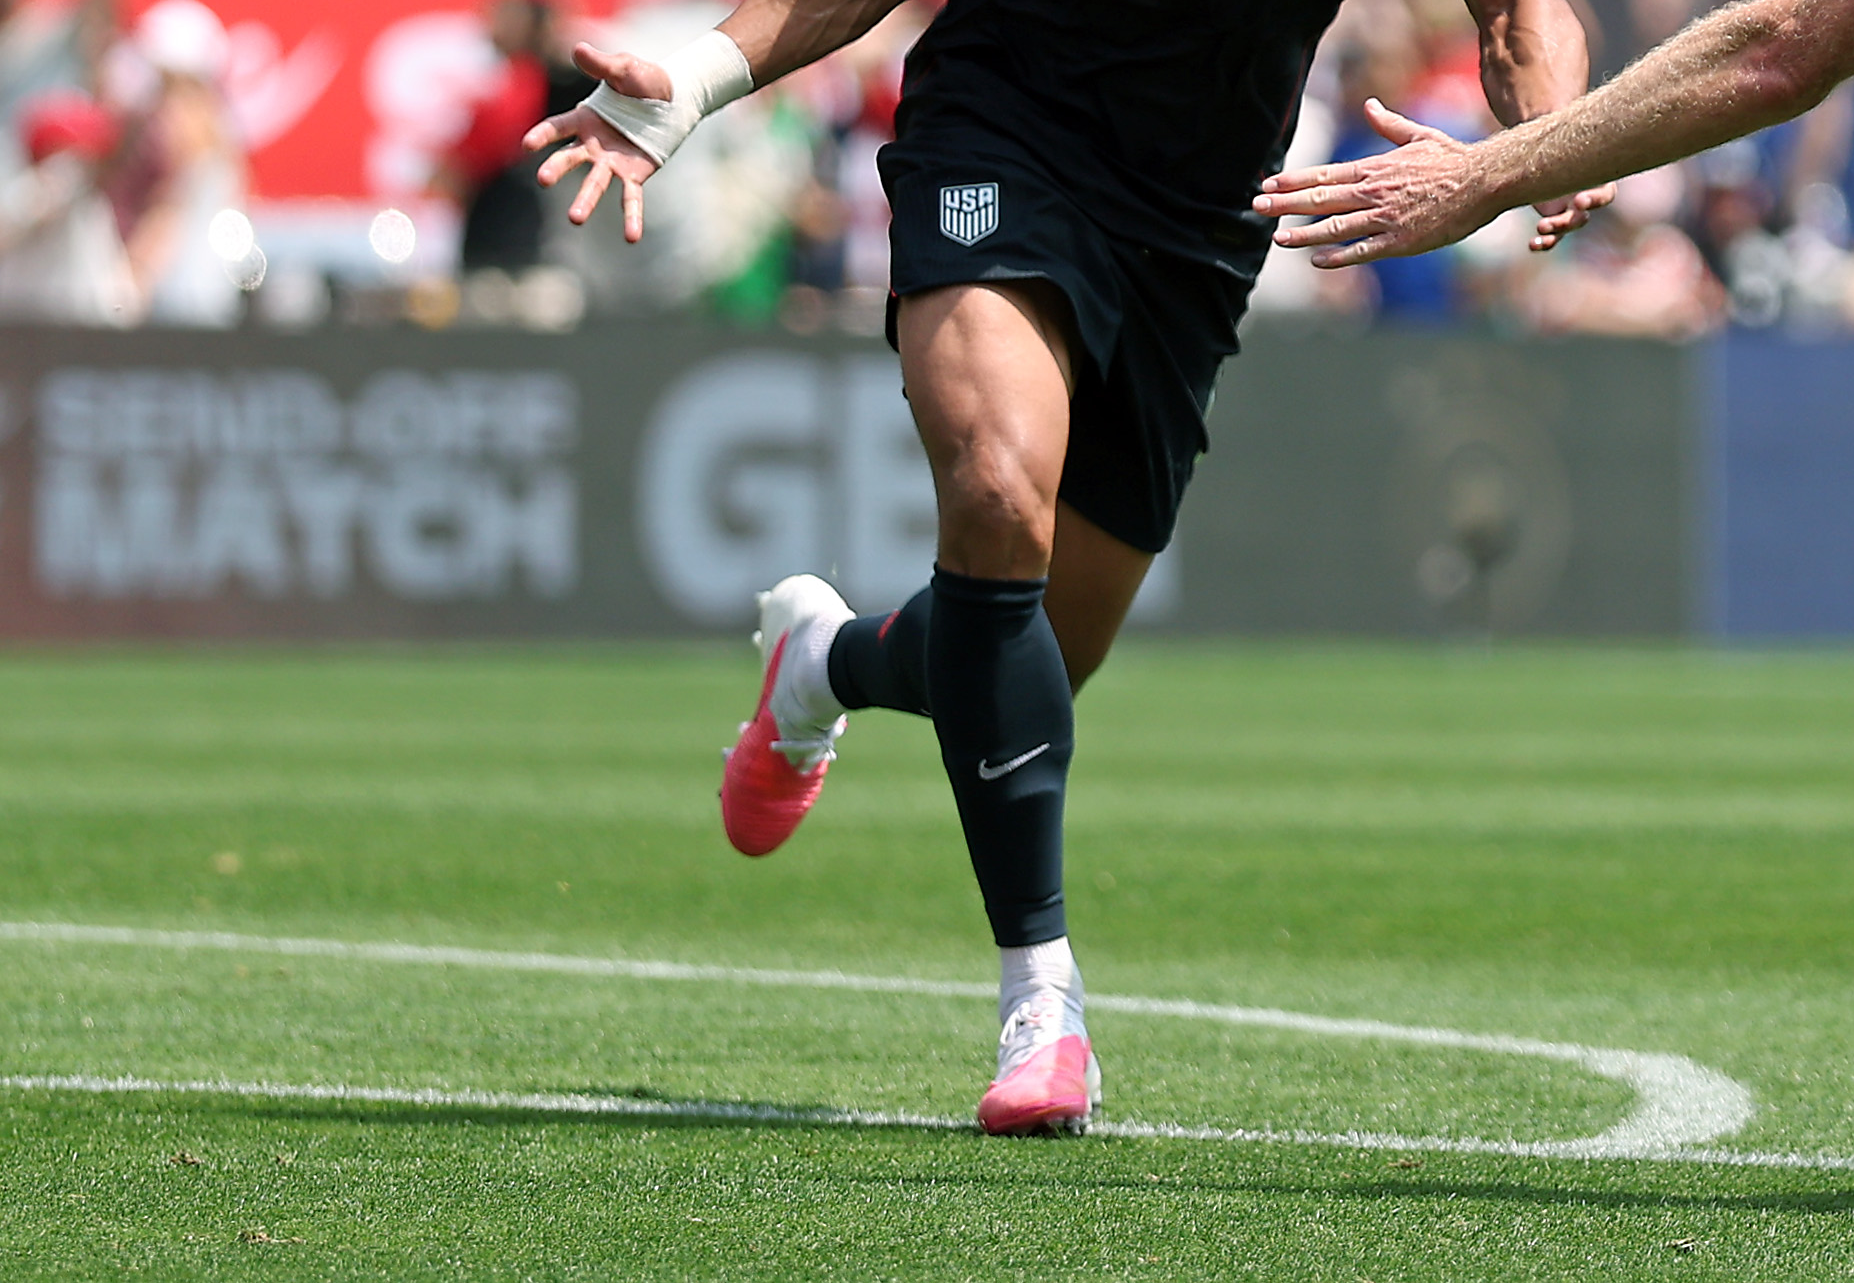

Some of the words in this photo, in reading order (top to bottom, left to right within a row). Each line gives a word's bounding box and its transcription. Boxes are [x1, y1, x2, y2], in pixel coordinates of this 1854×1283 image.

[945, 187, 993, 213] USA
[36, 369, 581, 453] SEND-OFF
[36, 455, 581, 601] MATCH
